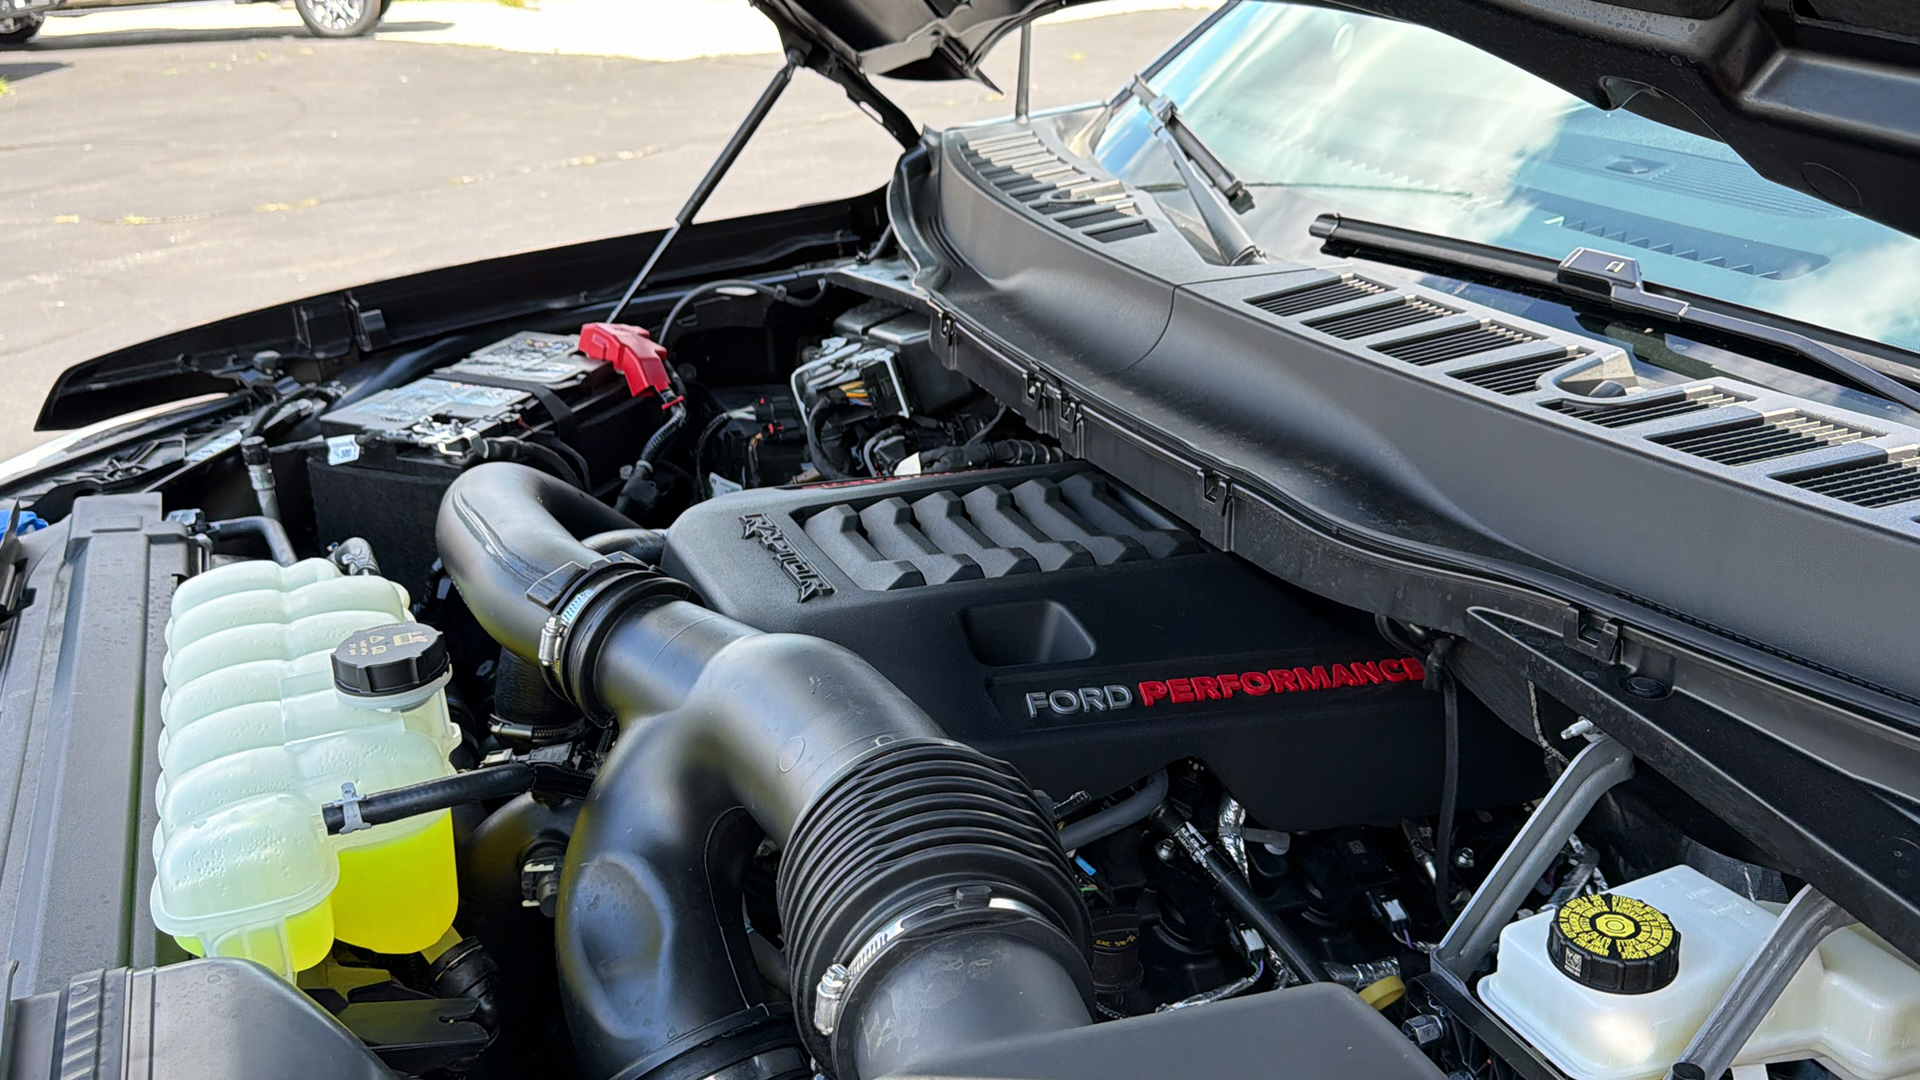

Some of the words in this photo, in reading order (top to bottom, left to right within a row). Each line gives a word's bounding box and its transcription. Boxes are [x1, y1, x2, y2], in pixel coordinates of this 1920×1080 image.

[739, 513, 838, 603] RAPTOR
[1025, 685, 1133, 717] FORD
[1137, 657, 1425, 706] PERFORMANCE
